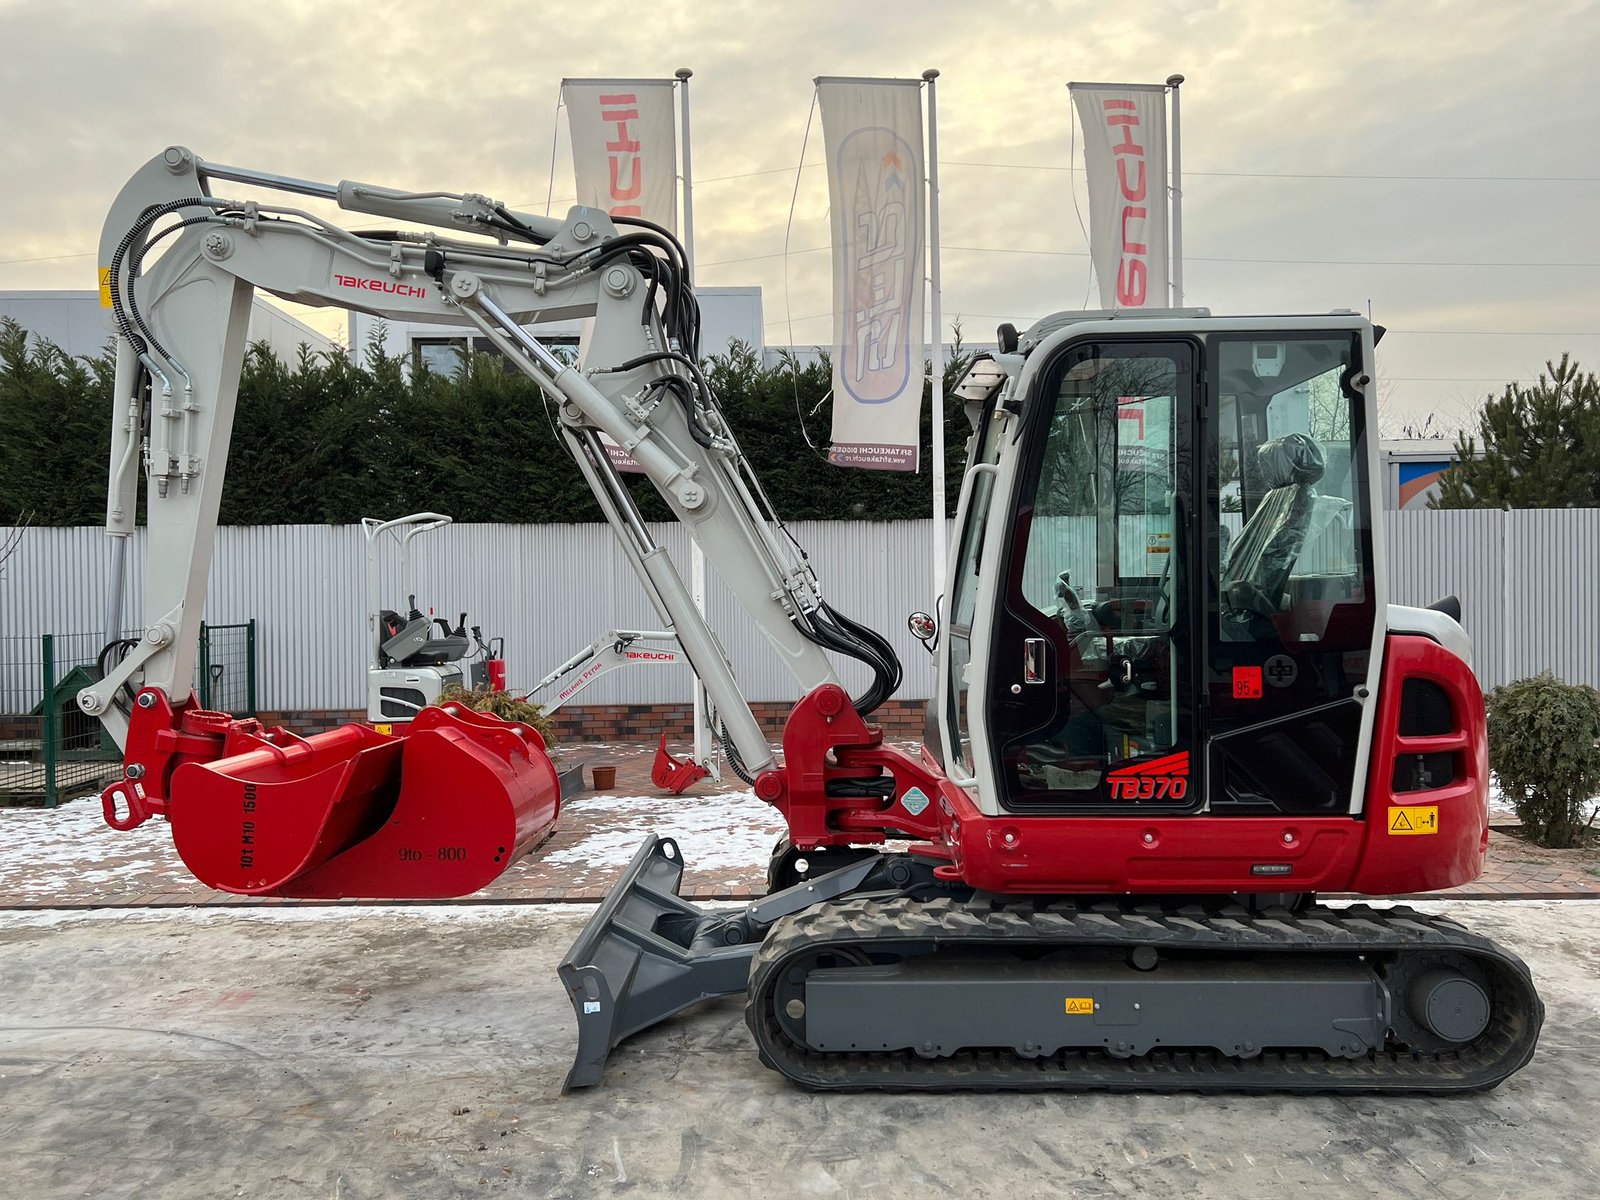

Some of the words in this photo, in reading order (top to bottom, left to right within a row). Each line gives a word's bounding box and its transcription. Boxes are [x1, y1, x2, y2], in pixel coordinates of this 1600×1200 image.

[334, 274, 426, 298] TAKEUCHI
[623, 651, 675, 661] TAKEUCHI
[243, 783, 257, 814] 1500
[1105, 776, 1188, 800] TB370
[437, 846, 467, 861] 800
